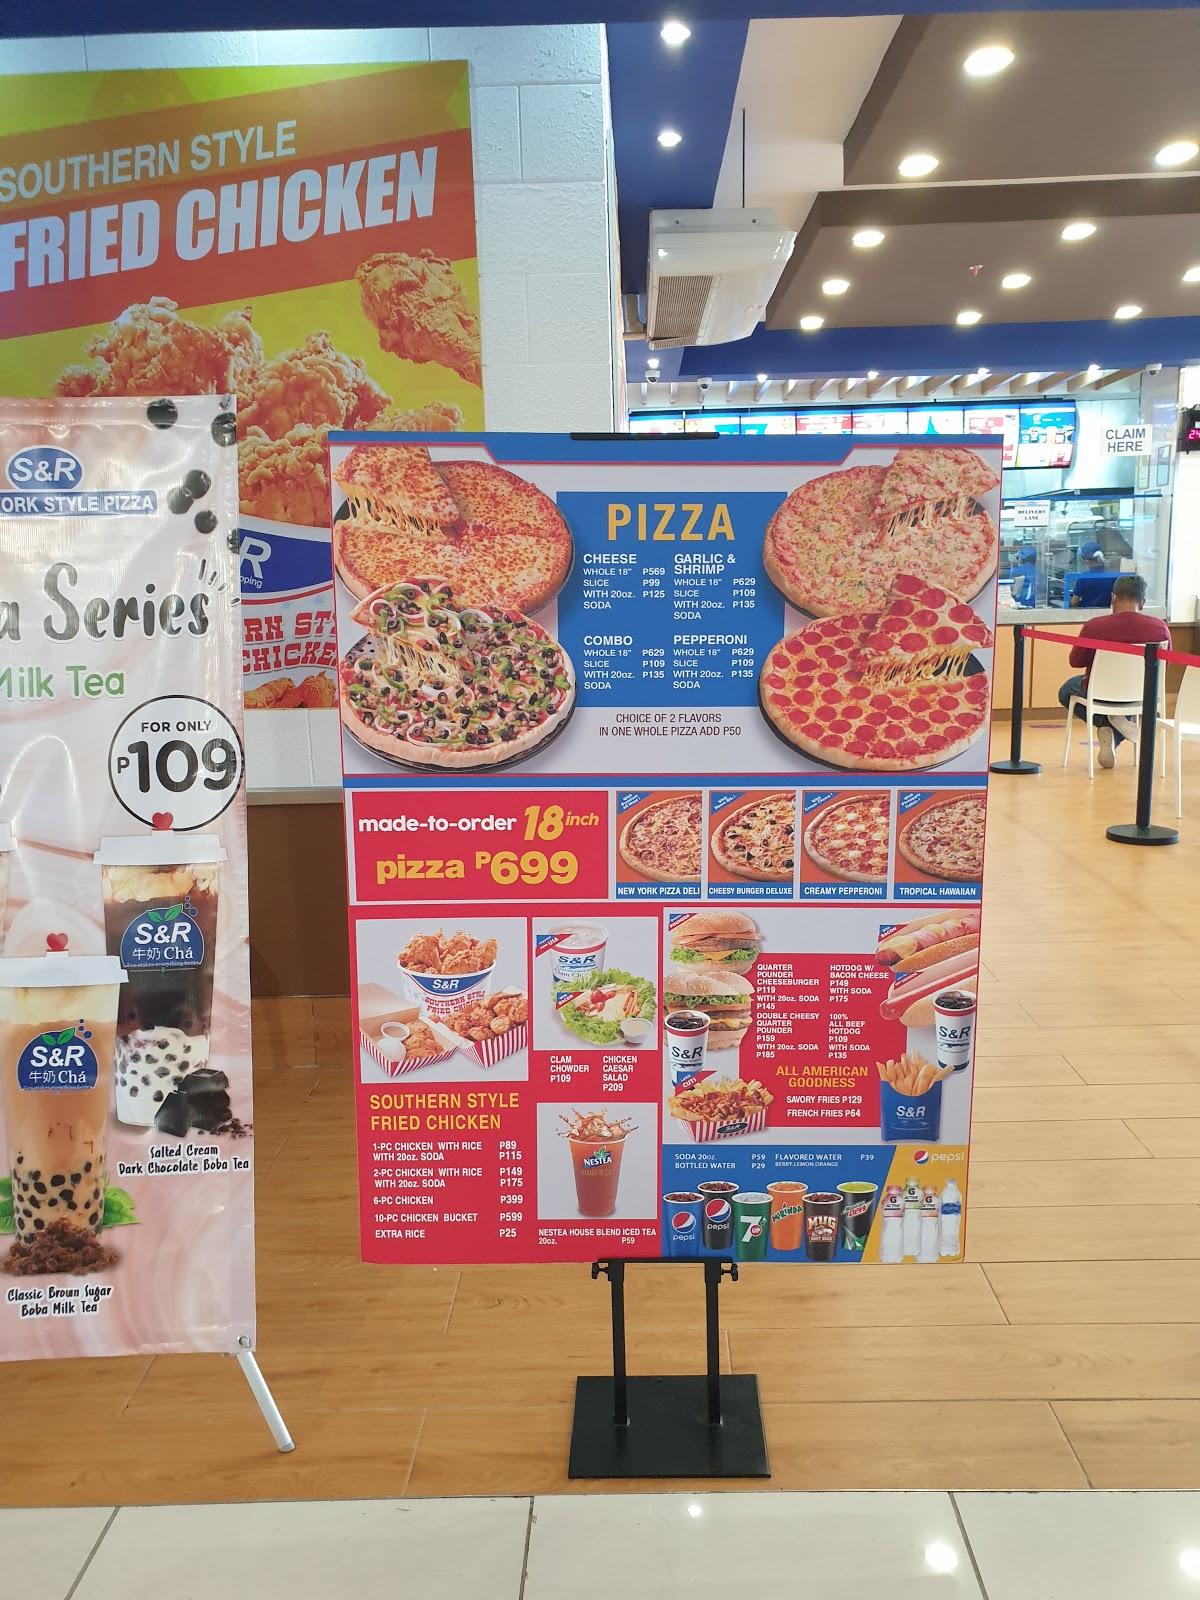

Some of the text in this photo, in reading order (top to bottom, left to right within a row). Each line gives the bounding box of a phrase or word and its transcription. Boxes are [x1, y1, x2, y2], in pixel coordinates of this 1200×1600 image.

[0, 120, 297, 202] SOUTHERN STYLE
[0, 146, 438, 292] FRIED CHICKEN
[1106, 428, 1146, 440] CLAIM
[1108, 441, 1142, 452] HERE
[13, 457, 75, 482] S&R
[0, 492, 153, 513] ORK STYLE PIZZA
[608, 503, 736, 541] PIZZA
[583, 554, 637, 564] CHEESE
[674, 554, 736, 564] GARLIC &
[583, 568, 616, 576] WHOLE
[643, 568, 665, 576] P569
[674, 565, 725, 575] SHRIMP
[583, 579, 660, 587] SLICE P99
[583, 590, 665, 598] WITH 20oz. P125
[43, 562, 209, 640] Series
[584, 636, 633, 646] COMBO
[673, 635, 747, 645] PEPPERONI
[66, 665, 125, 698] Tea
[616, 713, 722, 723] CHOICE OF 2 FLAVORS
[141, 721, 211, 733] FOR ONLY
[599, 726, 741, 736] IN ONE WHOLE PIZZA ADD P50
[117, 738, 237, 793] P109
[359, 805, 599, 841] made-to-order 18 inch
[376, 851, 579, 885] pizza P699
[618, 887, 700, 895] NEW YORK PIZZA DELI
[709, 887, 792, 895] CHEESY BURGER DELUXE
[804, 887, 882, 896] CREAMY PEPPERONI
[899, 887, 976, 896] TROPICAL HAWAIIAN
[135, 922, 192, 945] S&R
[132, 947, 160, 961] 牛奶
[164, 946, 193, 959] Chá
[432, 979, 459, 989] S&R
[939, 1026, 971, 1039] S&R
[30, 1045, 85, 1067] S&R
[672, 1046, 703, 1059] S&R
[776, 1066, 868, 1076] ALL AMERICAN
[28, 1070, 55, 1084] 牛奶
[58, 1069, 86, 1084] Chá
[551, 1074, 571, 1082] P109
[603, 1083, 624, 1091] P209
[788, 1078, 855, 1088] GOODNESS
[370, 1093, 519, 1109] SOUTHERN STYLE
[787, 1096, 815, 1104] SAVORY
[787, 1109, 860, 1117] FRENCH FRIES P64
[896, 1105, 926, 1117] S&R
[371, 1115, 501, 1130] FRIED CHICKEN
[373, 1141, 517, 1151] 1-PC CHICKEN WITH RICE P89
[150, 1145, 218, 1159] Salted Cream
[373, 1153, 394, 1161] WITH
[397, 1153, 418, 1161] 20oz.
[499, 1151, 522, 1160] P115
[930, 1151, 964, 1162] pepsi
[583, 1156, 612, 1166] NESTEA
[119, 1158, 249, 1175] Dark Chocolate Boba Tea
[373, 1195, 523, 1205] 6-PC CHICKEN P399
[375, 1213, 522, 1222] 10-PC CHICKEN BUCKET P599
[807, 1217, 836, 1228] MUG
[707, 1222, 729, 1231] pepsi
[375, 1229, 516, 1238] EXTRA RICE P25
[642, 1228, 656, 1236] TEA
[673, 1233, 695, 1241] pepsi
[538, 1237, 635, 1245] 20oz. P59
[8, 1285, 111, 1301] Classic Brown Sugar
[22, 1301, 97, 1316] Boba Milk Tea
